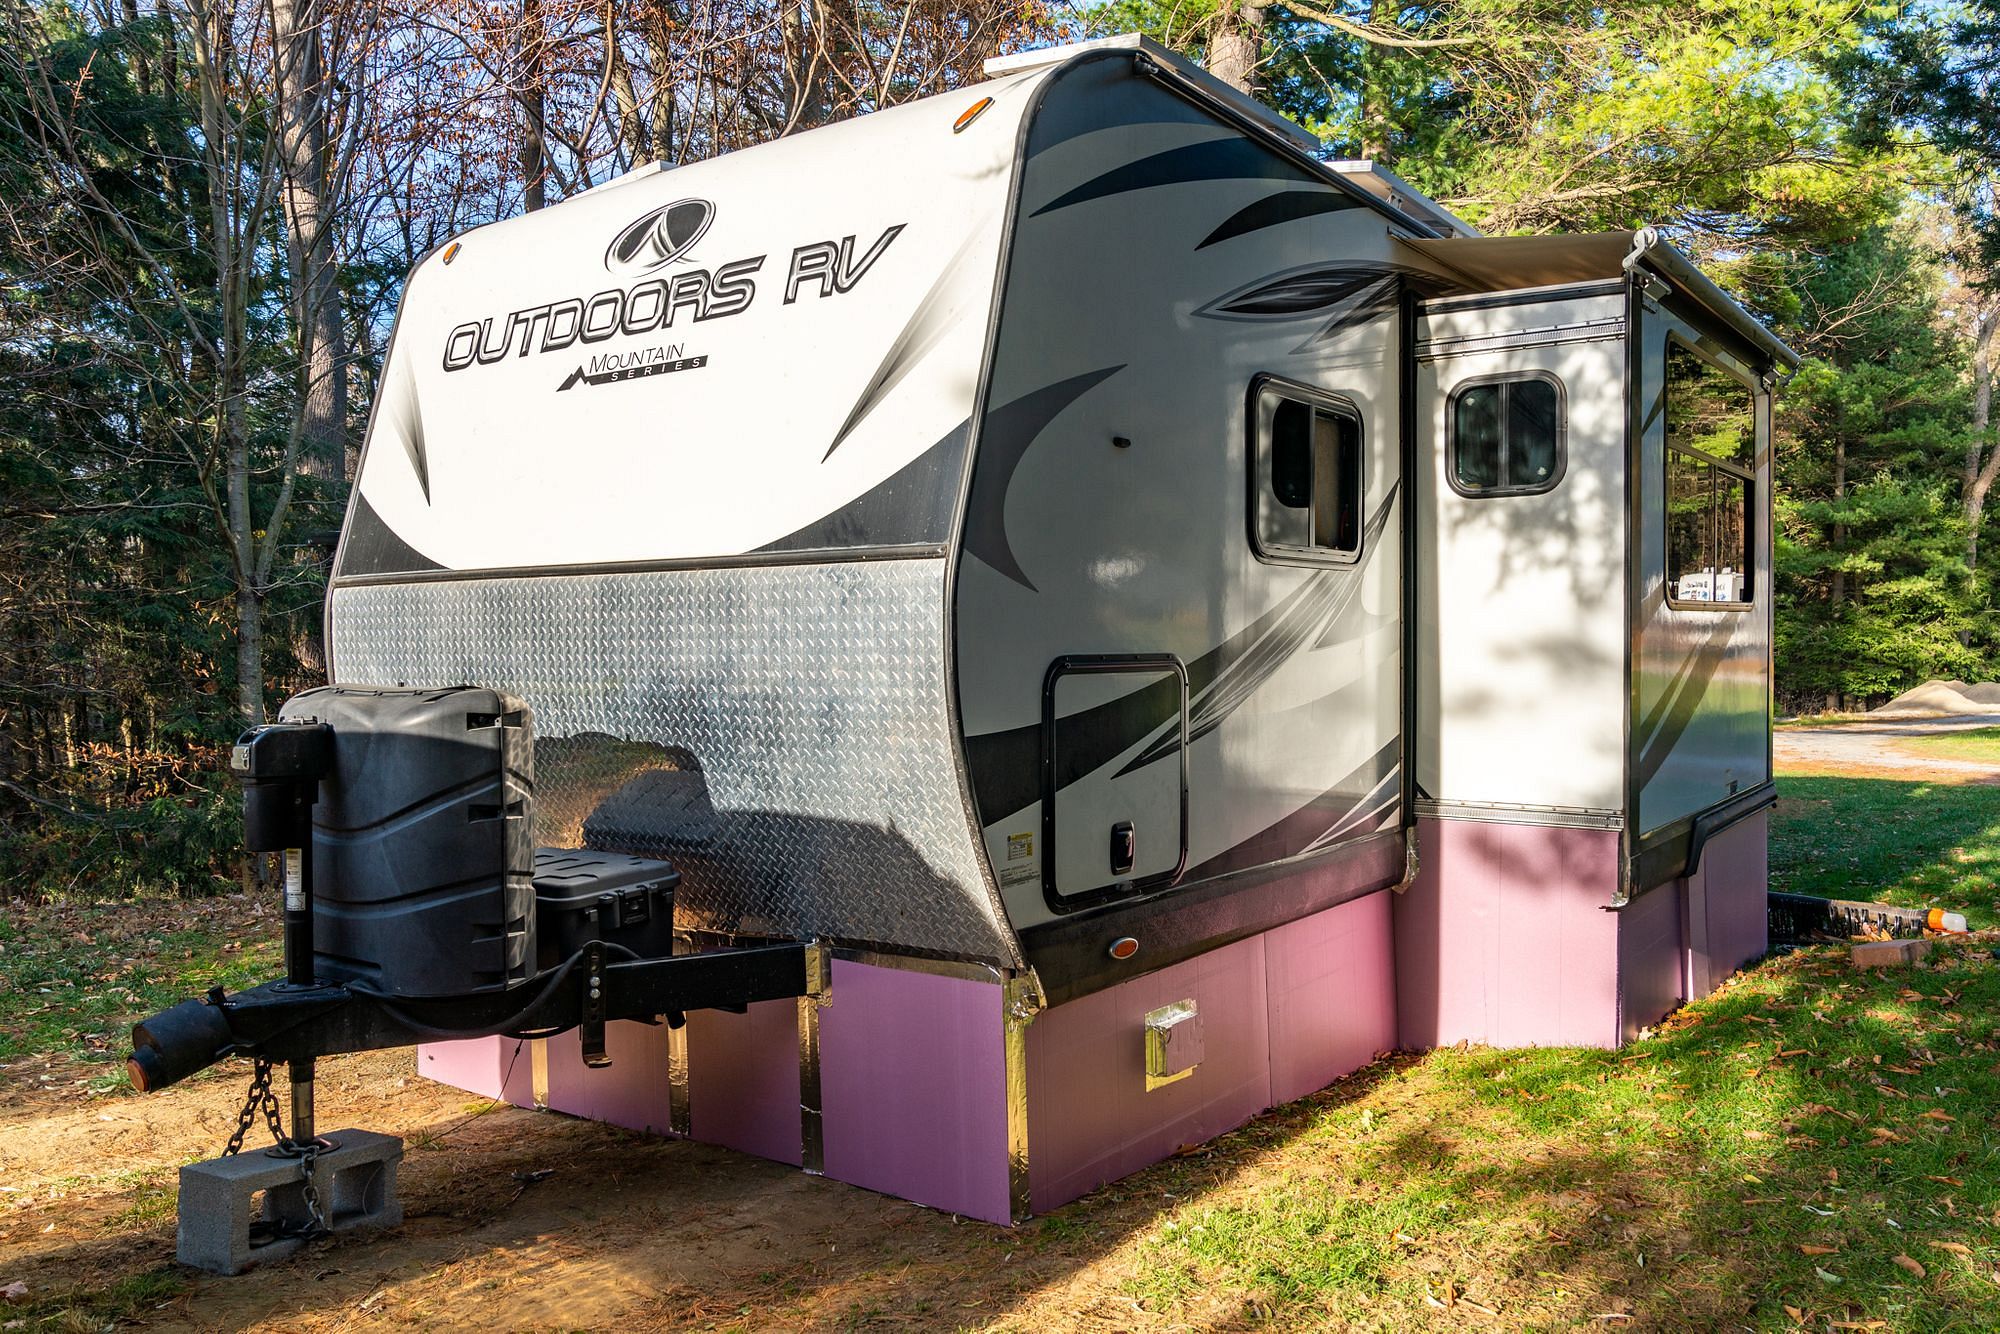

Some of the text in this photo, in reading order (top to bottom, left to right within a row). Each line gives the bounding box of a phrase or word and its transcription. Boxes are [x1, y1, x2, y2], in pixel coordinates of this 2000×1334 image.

[442, 223, 908, 371] OUTDOORS RV
[589, 342, 684, 374] MOUNTAIN
[611, 357, 702, 382] SERIES
